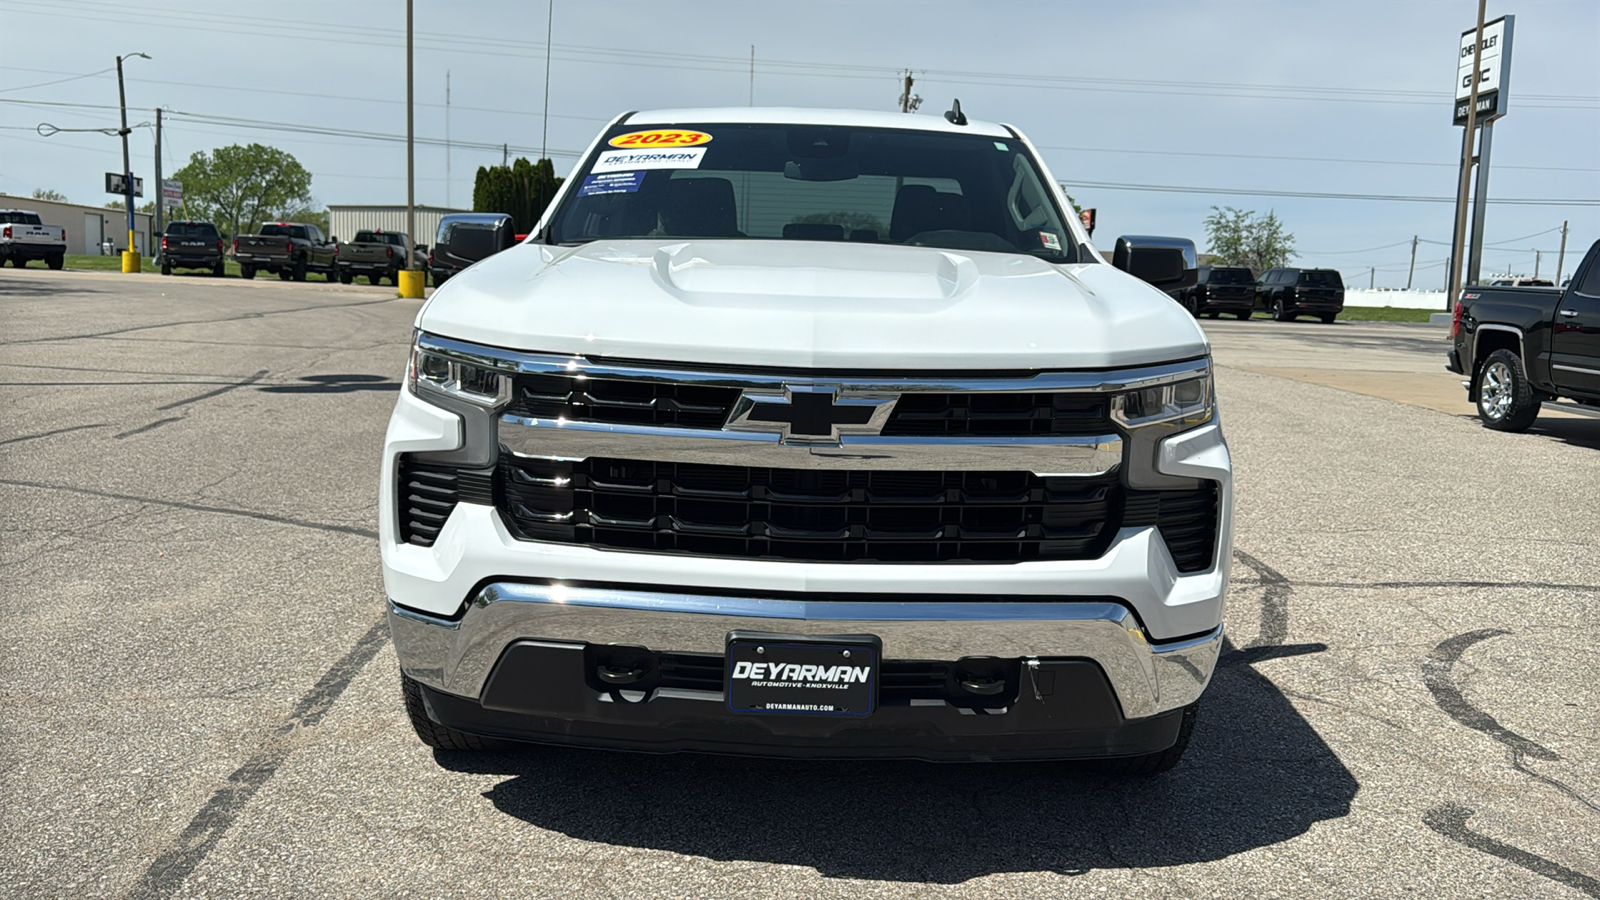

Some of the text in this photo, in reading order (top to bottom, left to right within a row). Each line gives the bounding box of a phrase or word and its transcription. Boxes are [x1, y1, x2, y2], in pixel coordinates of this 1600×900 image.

[1463, 68, 1490, 88] GC
[618, 133, 703, 145] 2023
[604, 153, 698, 163] DEYARMAN
[732, 661, 870, 683] DEYARMAN
[751, 681, 849, 690] AUTOMOTIVE-KNOXVILLE
[766, 703, 834, 712] DEYARMANAUTO.COM
